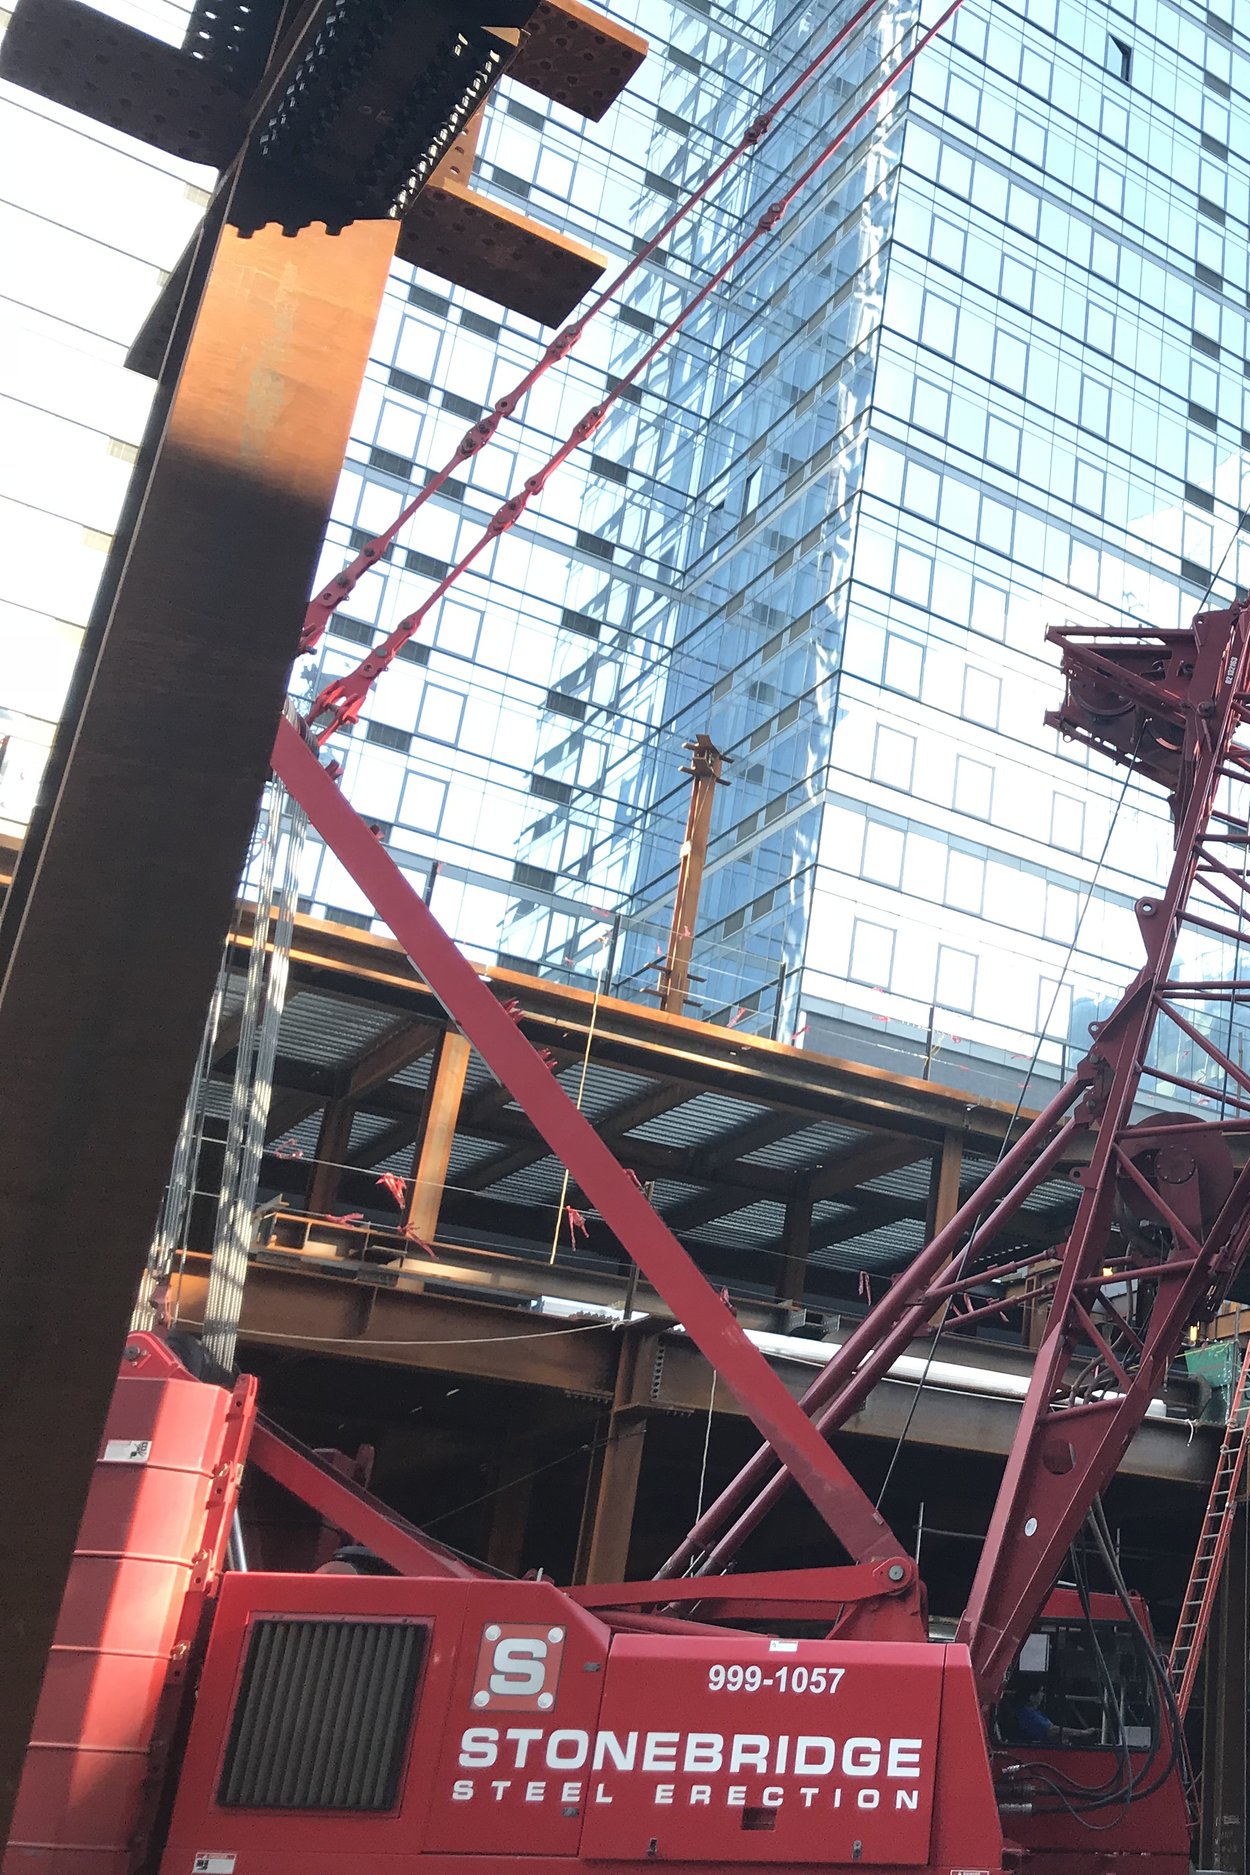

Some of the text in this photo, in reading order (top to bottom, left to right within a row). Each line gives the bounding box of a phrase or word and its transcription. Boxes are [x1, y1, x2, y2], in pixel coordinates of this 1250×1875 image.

[489, 1638, 548, 1695] S
[708, 1664, 846, 1694] 999-1057
[458, 1727, 923, 1778] STONEBRIDGE
[451, 1780, 919, 1810] STEEL ERECTION
